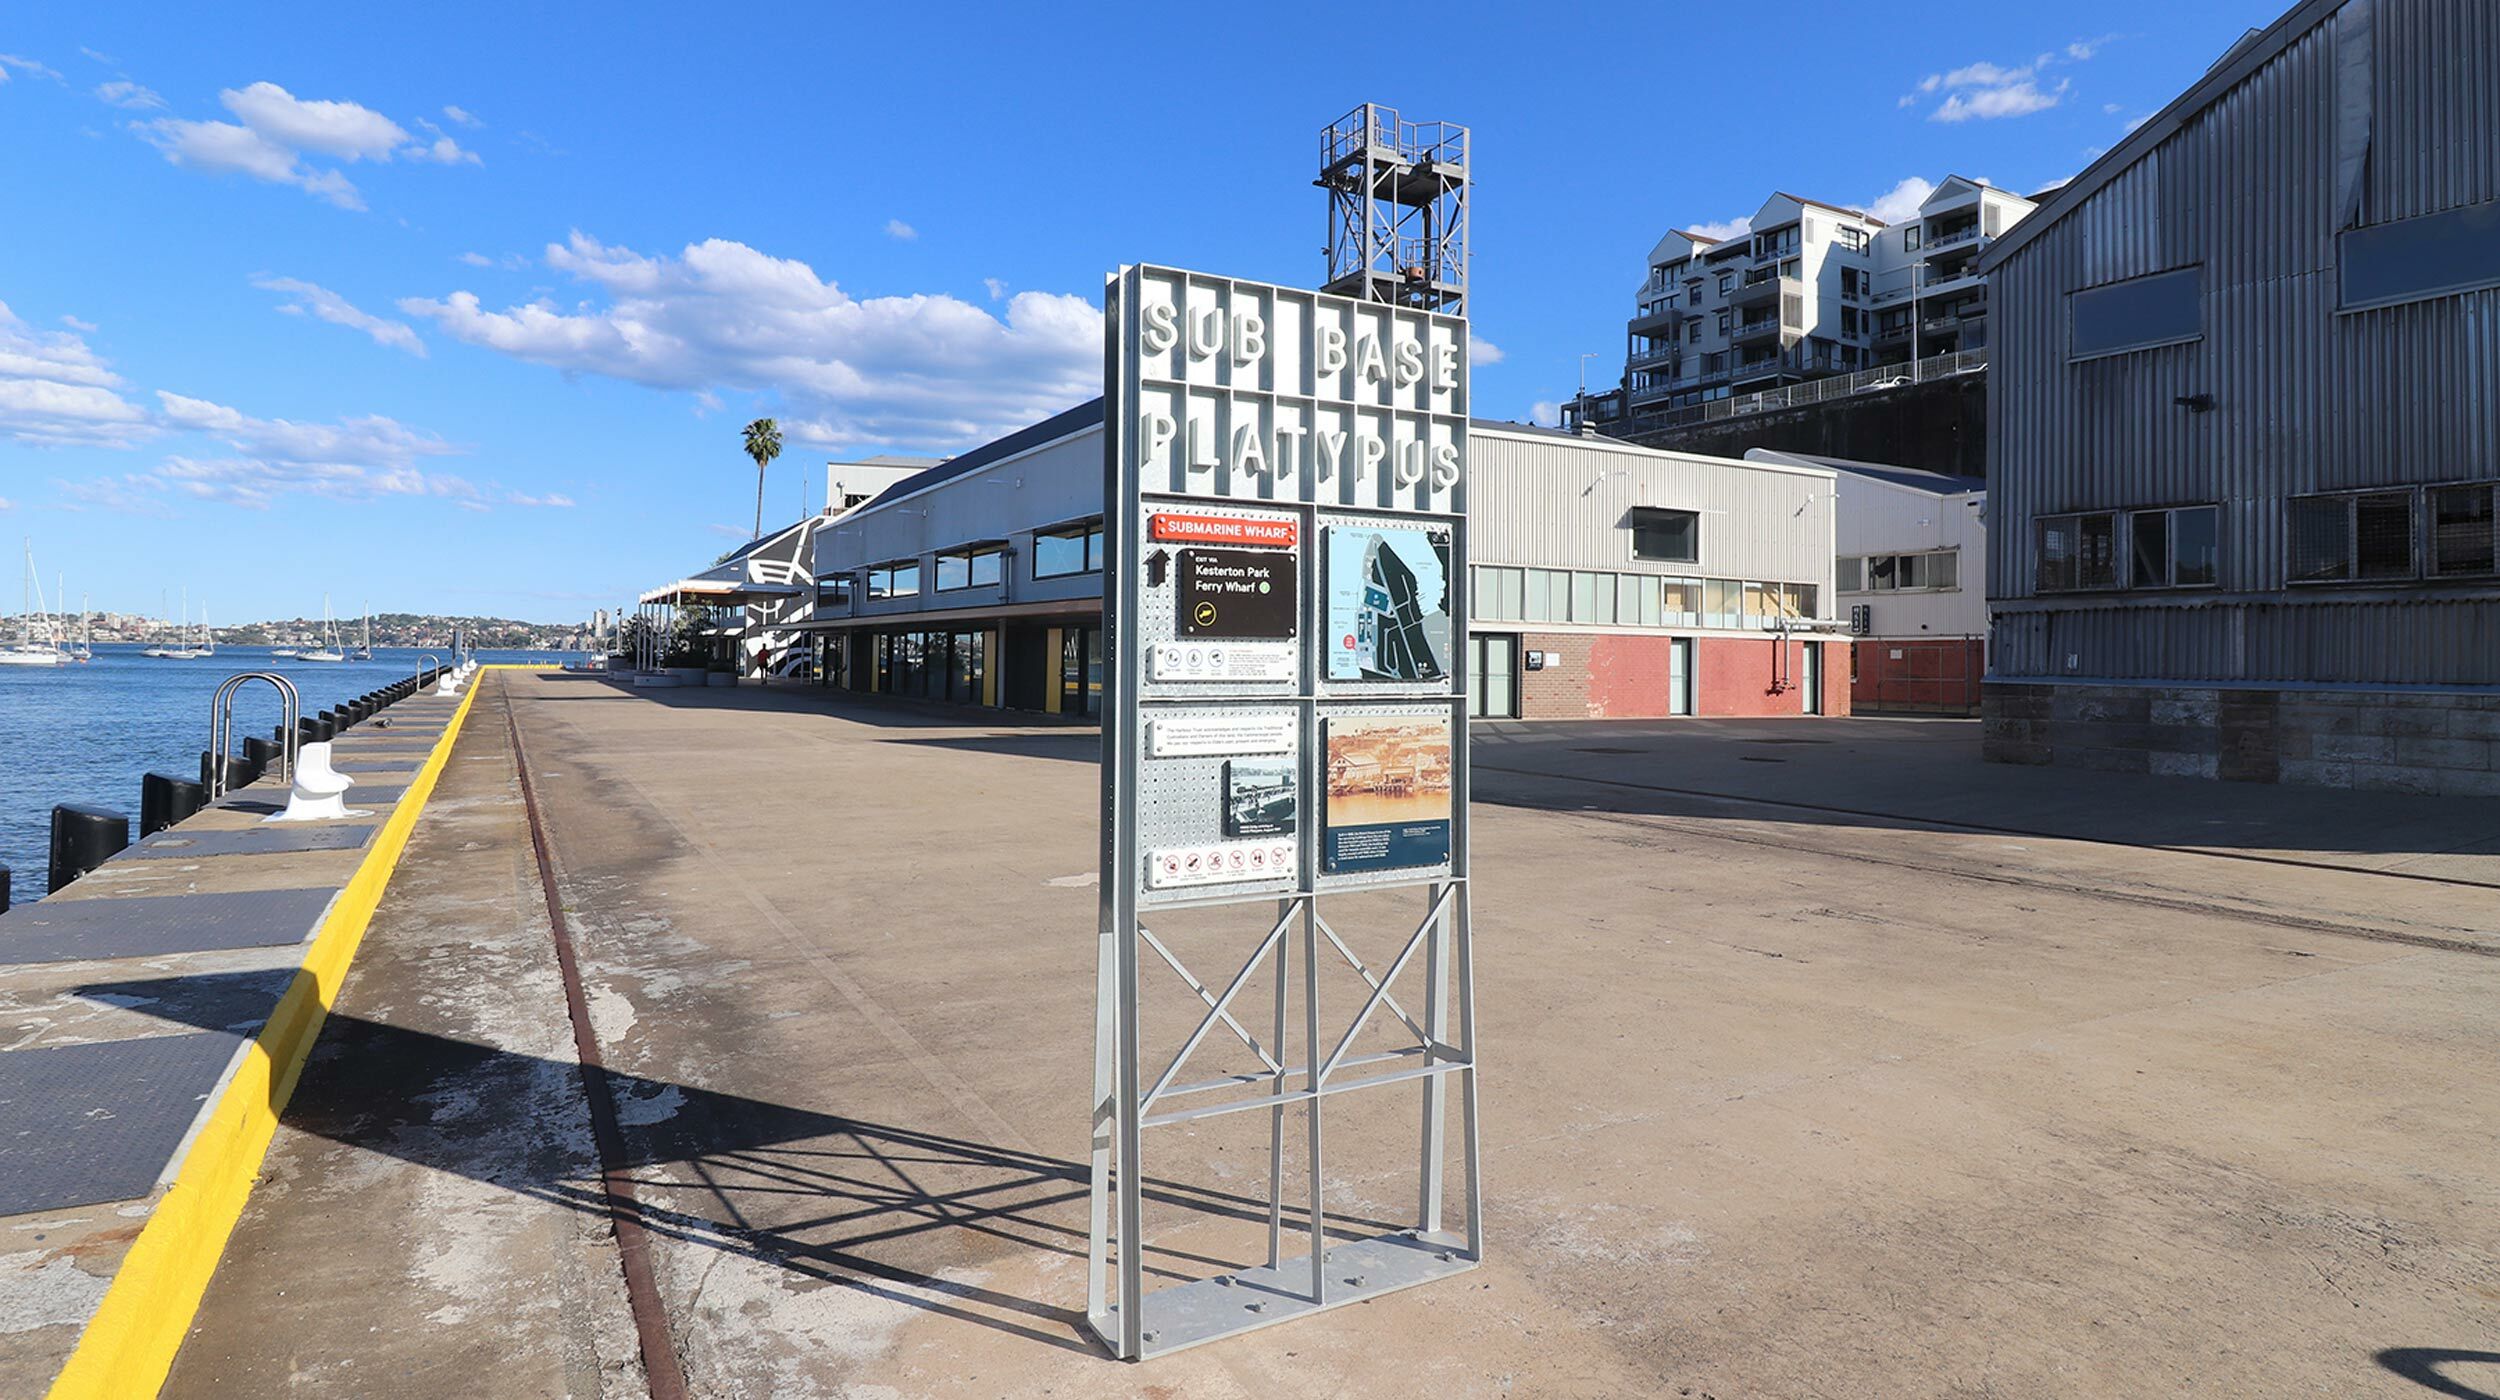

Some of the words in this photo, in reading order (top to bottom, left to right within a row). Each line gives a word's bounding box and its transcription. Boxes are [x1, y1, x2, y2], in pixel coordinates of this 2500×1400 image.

[1142, 300, 1266, 366] SUB
[1318, 325, 1458, 391] BASE
[1142, 411, 1460, 488] PLATYPUS
[1167, 520, 1242, 537] SUBMARINE
[1244, 524, 1289, 540] WHARF
[1195, 564, 1246, 577] Kesterton
[1247, 566, 1270, 578] Park
[1195, 580, 1223, 594] Ferry
[1224, 581, 1256, 593] Wharf
